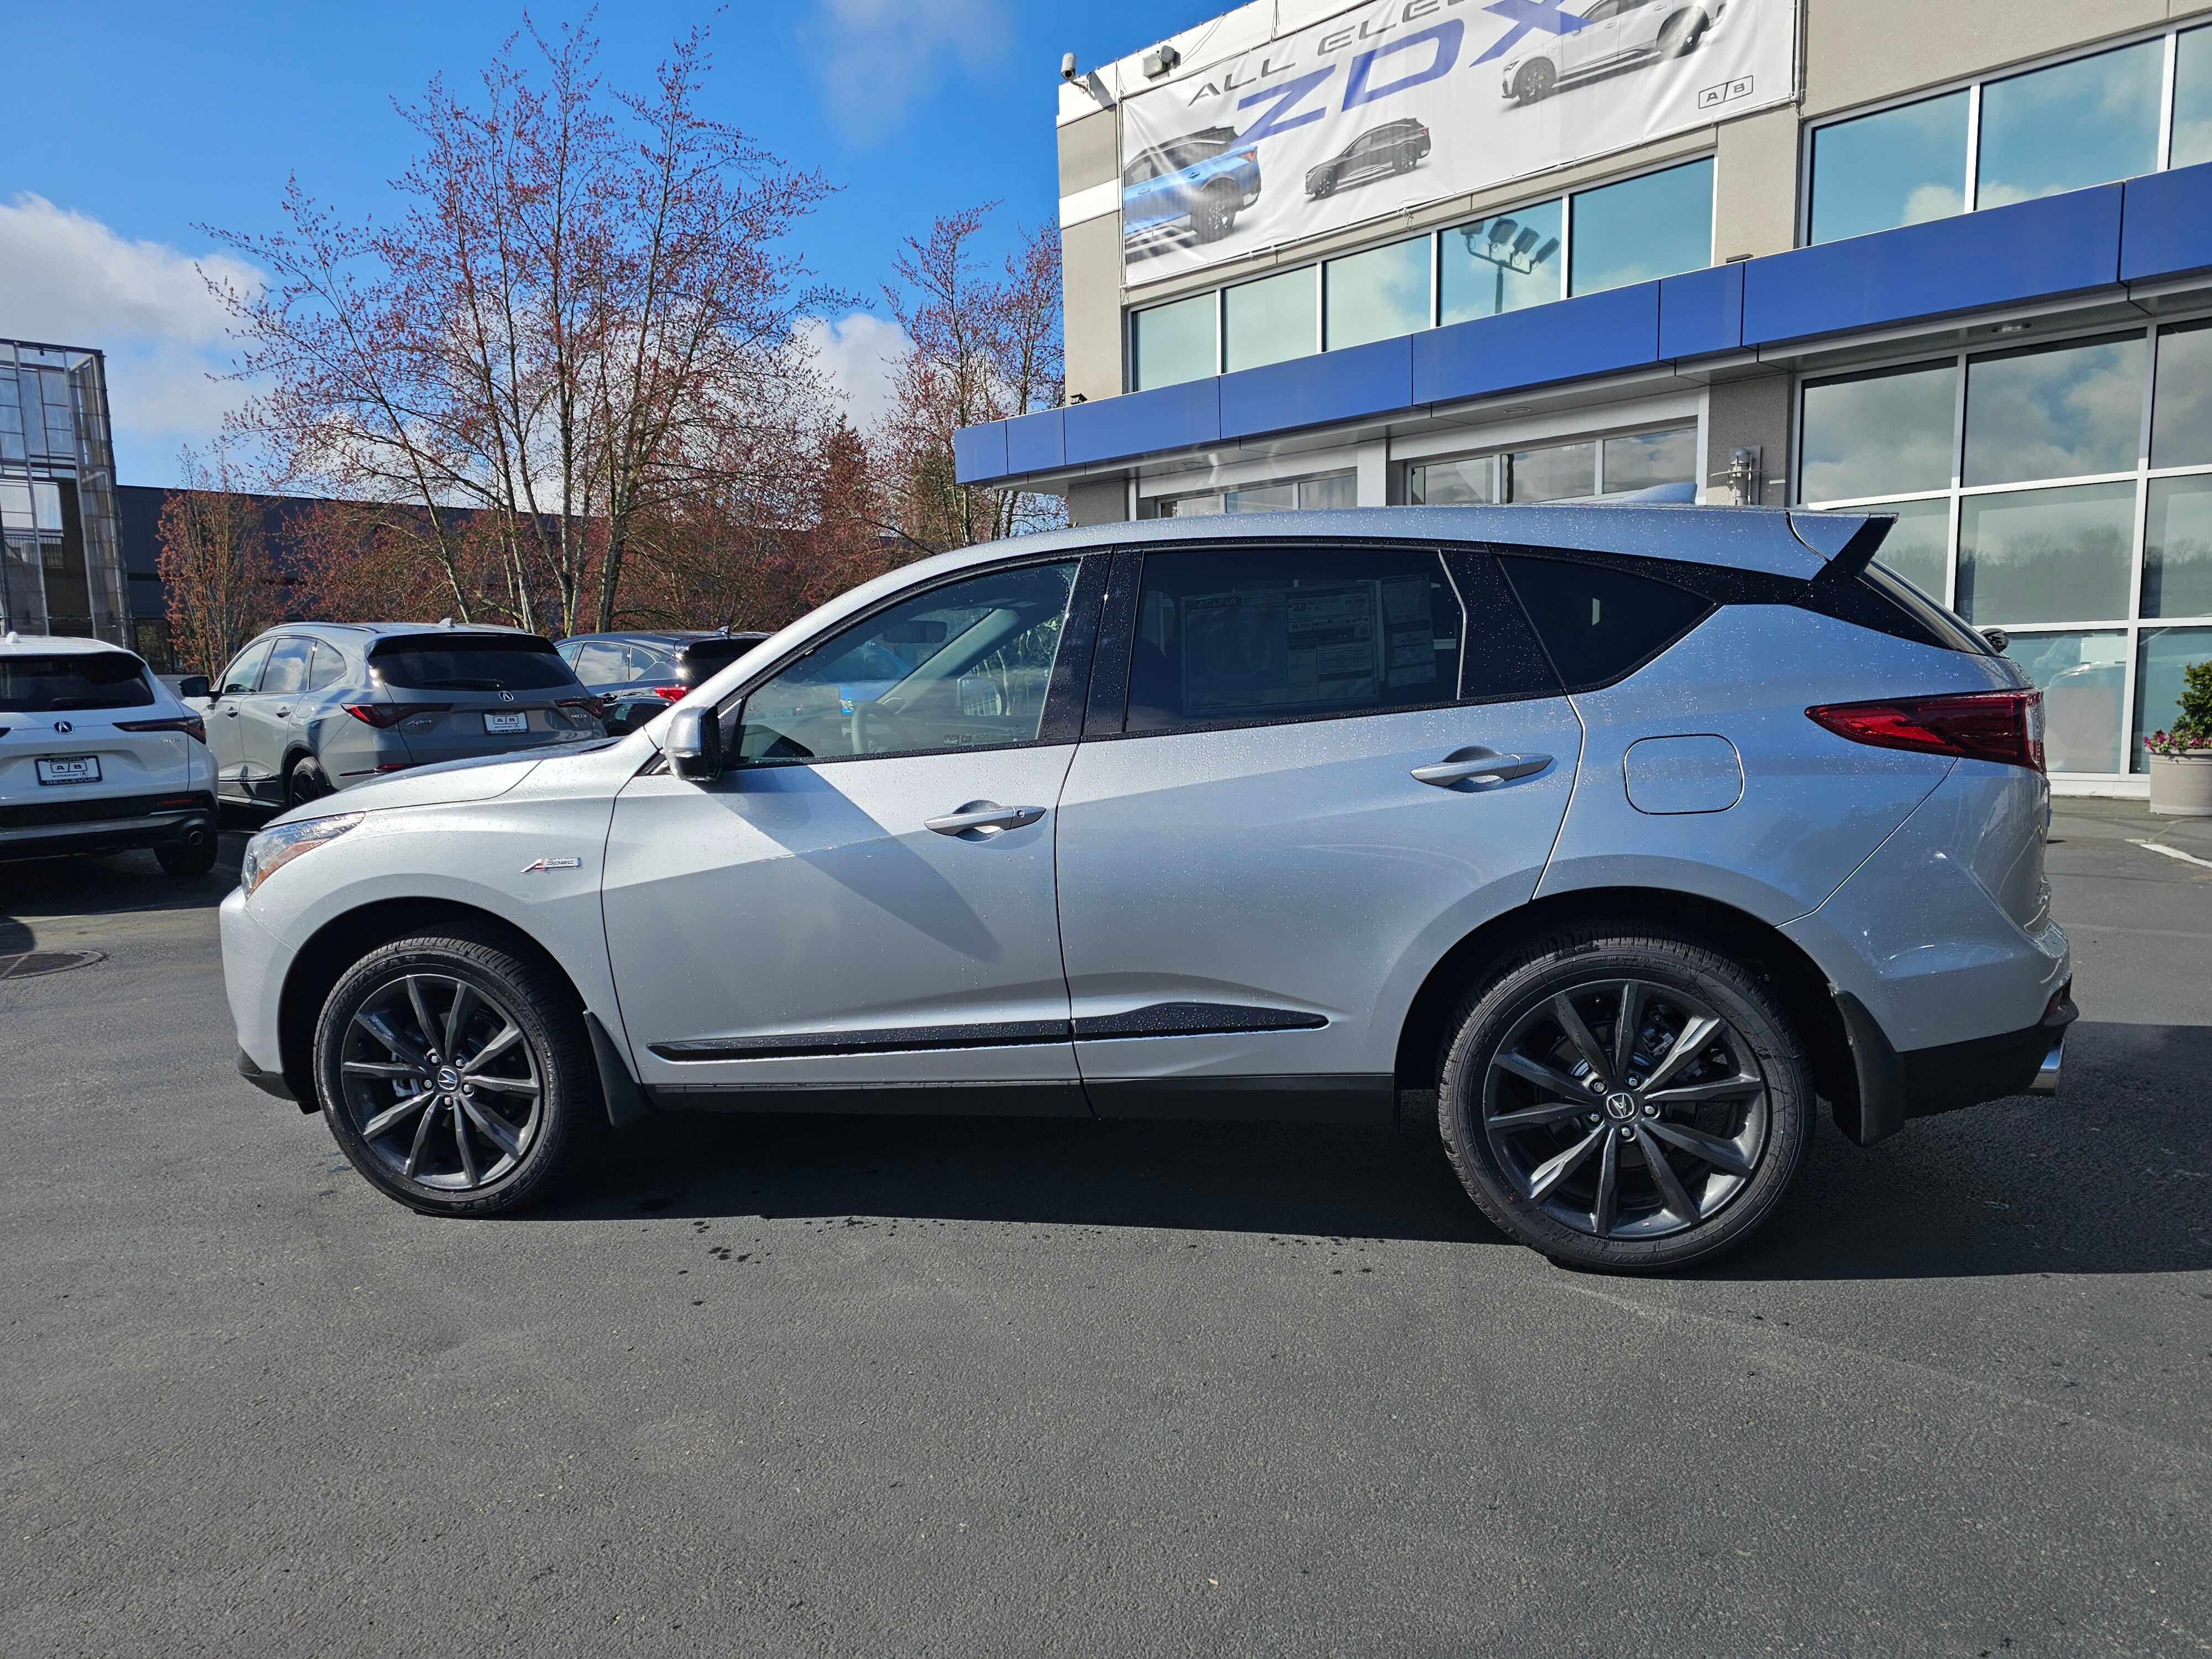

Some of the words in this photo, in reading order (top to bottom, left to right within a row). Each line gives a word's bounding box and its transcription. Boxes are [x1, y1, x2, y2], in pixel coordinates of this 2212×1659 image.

[1188, 59, 1296, 107] ALL
[1318, 0, 1467, 56] ELE
[1230, 0, 1598, 148] ZDX
[1198, 598, 1237, 607] ACURA
[1293, 602, 1306, 612] 23
